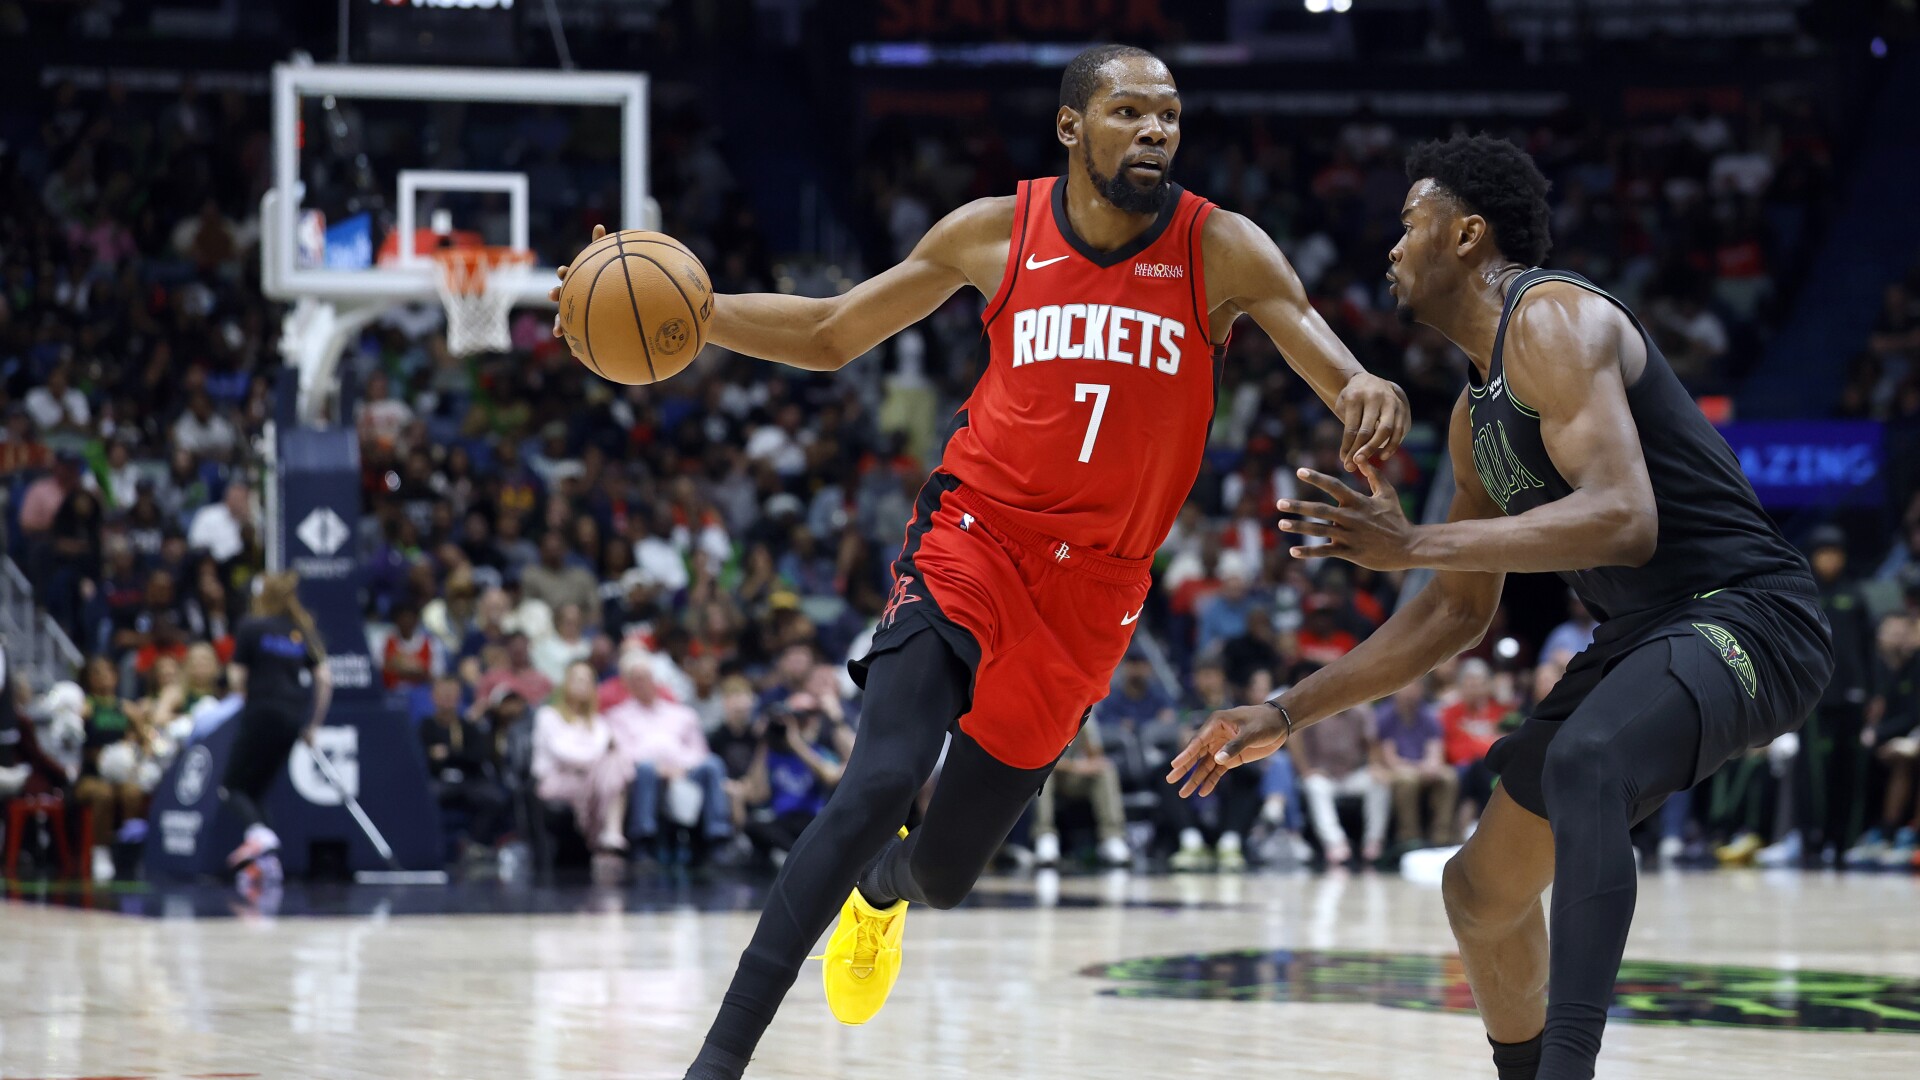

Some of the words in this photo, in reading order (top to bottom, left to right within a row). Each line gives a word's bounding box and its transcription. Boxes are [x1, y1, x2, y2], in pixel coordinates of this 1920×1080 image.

[1134, 262, 1183, 272] MEMORIAL
[1134, 268, 1184, 278] HERMANN
[1013, 303, 1185, 376] ROCKETS
[1074, 382, 1110, 463] 7
[1472, 419, 1545, 516] OLA
